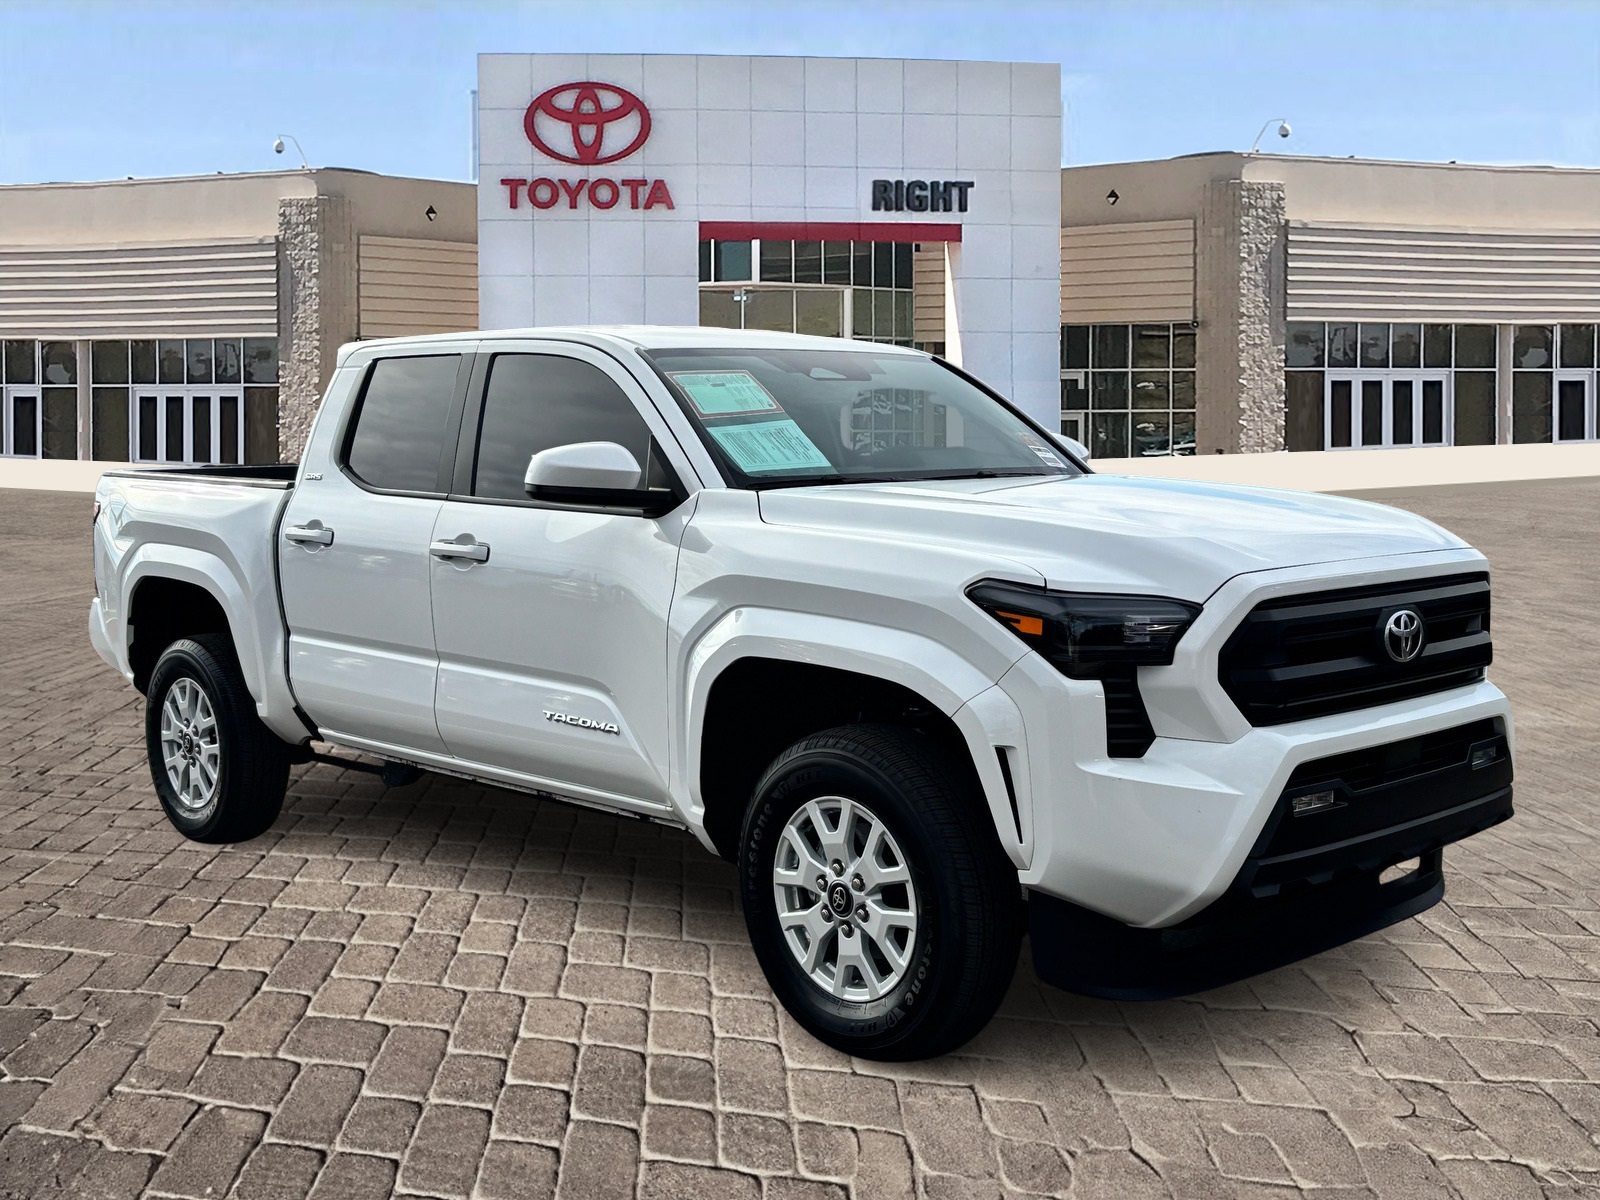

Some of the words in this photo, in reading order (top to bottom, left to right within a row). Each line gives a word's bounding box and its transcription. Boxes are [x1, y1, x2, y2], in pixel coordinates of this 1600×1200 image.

[500, 177, 675, 210] TOYOTA
[871, 179, 975, 213] RIGHT
[542, 709, 620, 735] TACOMA
